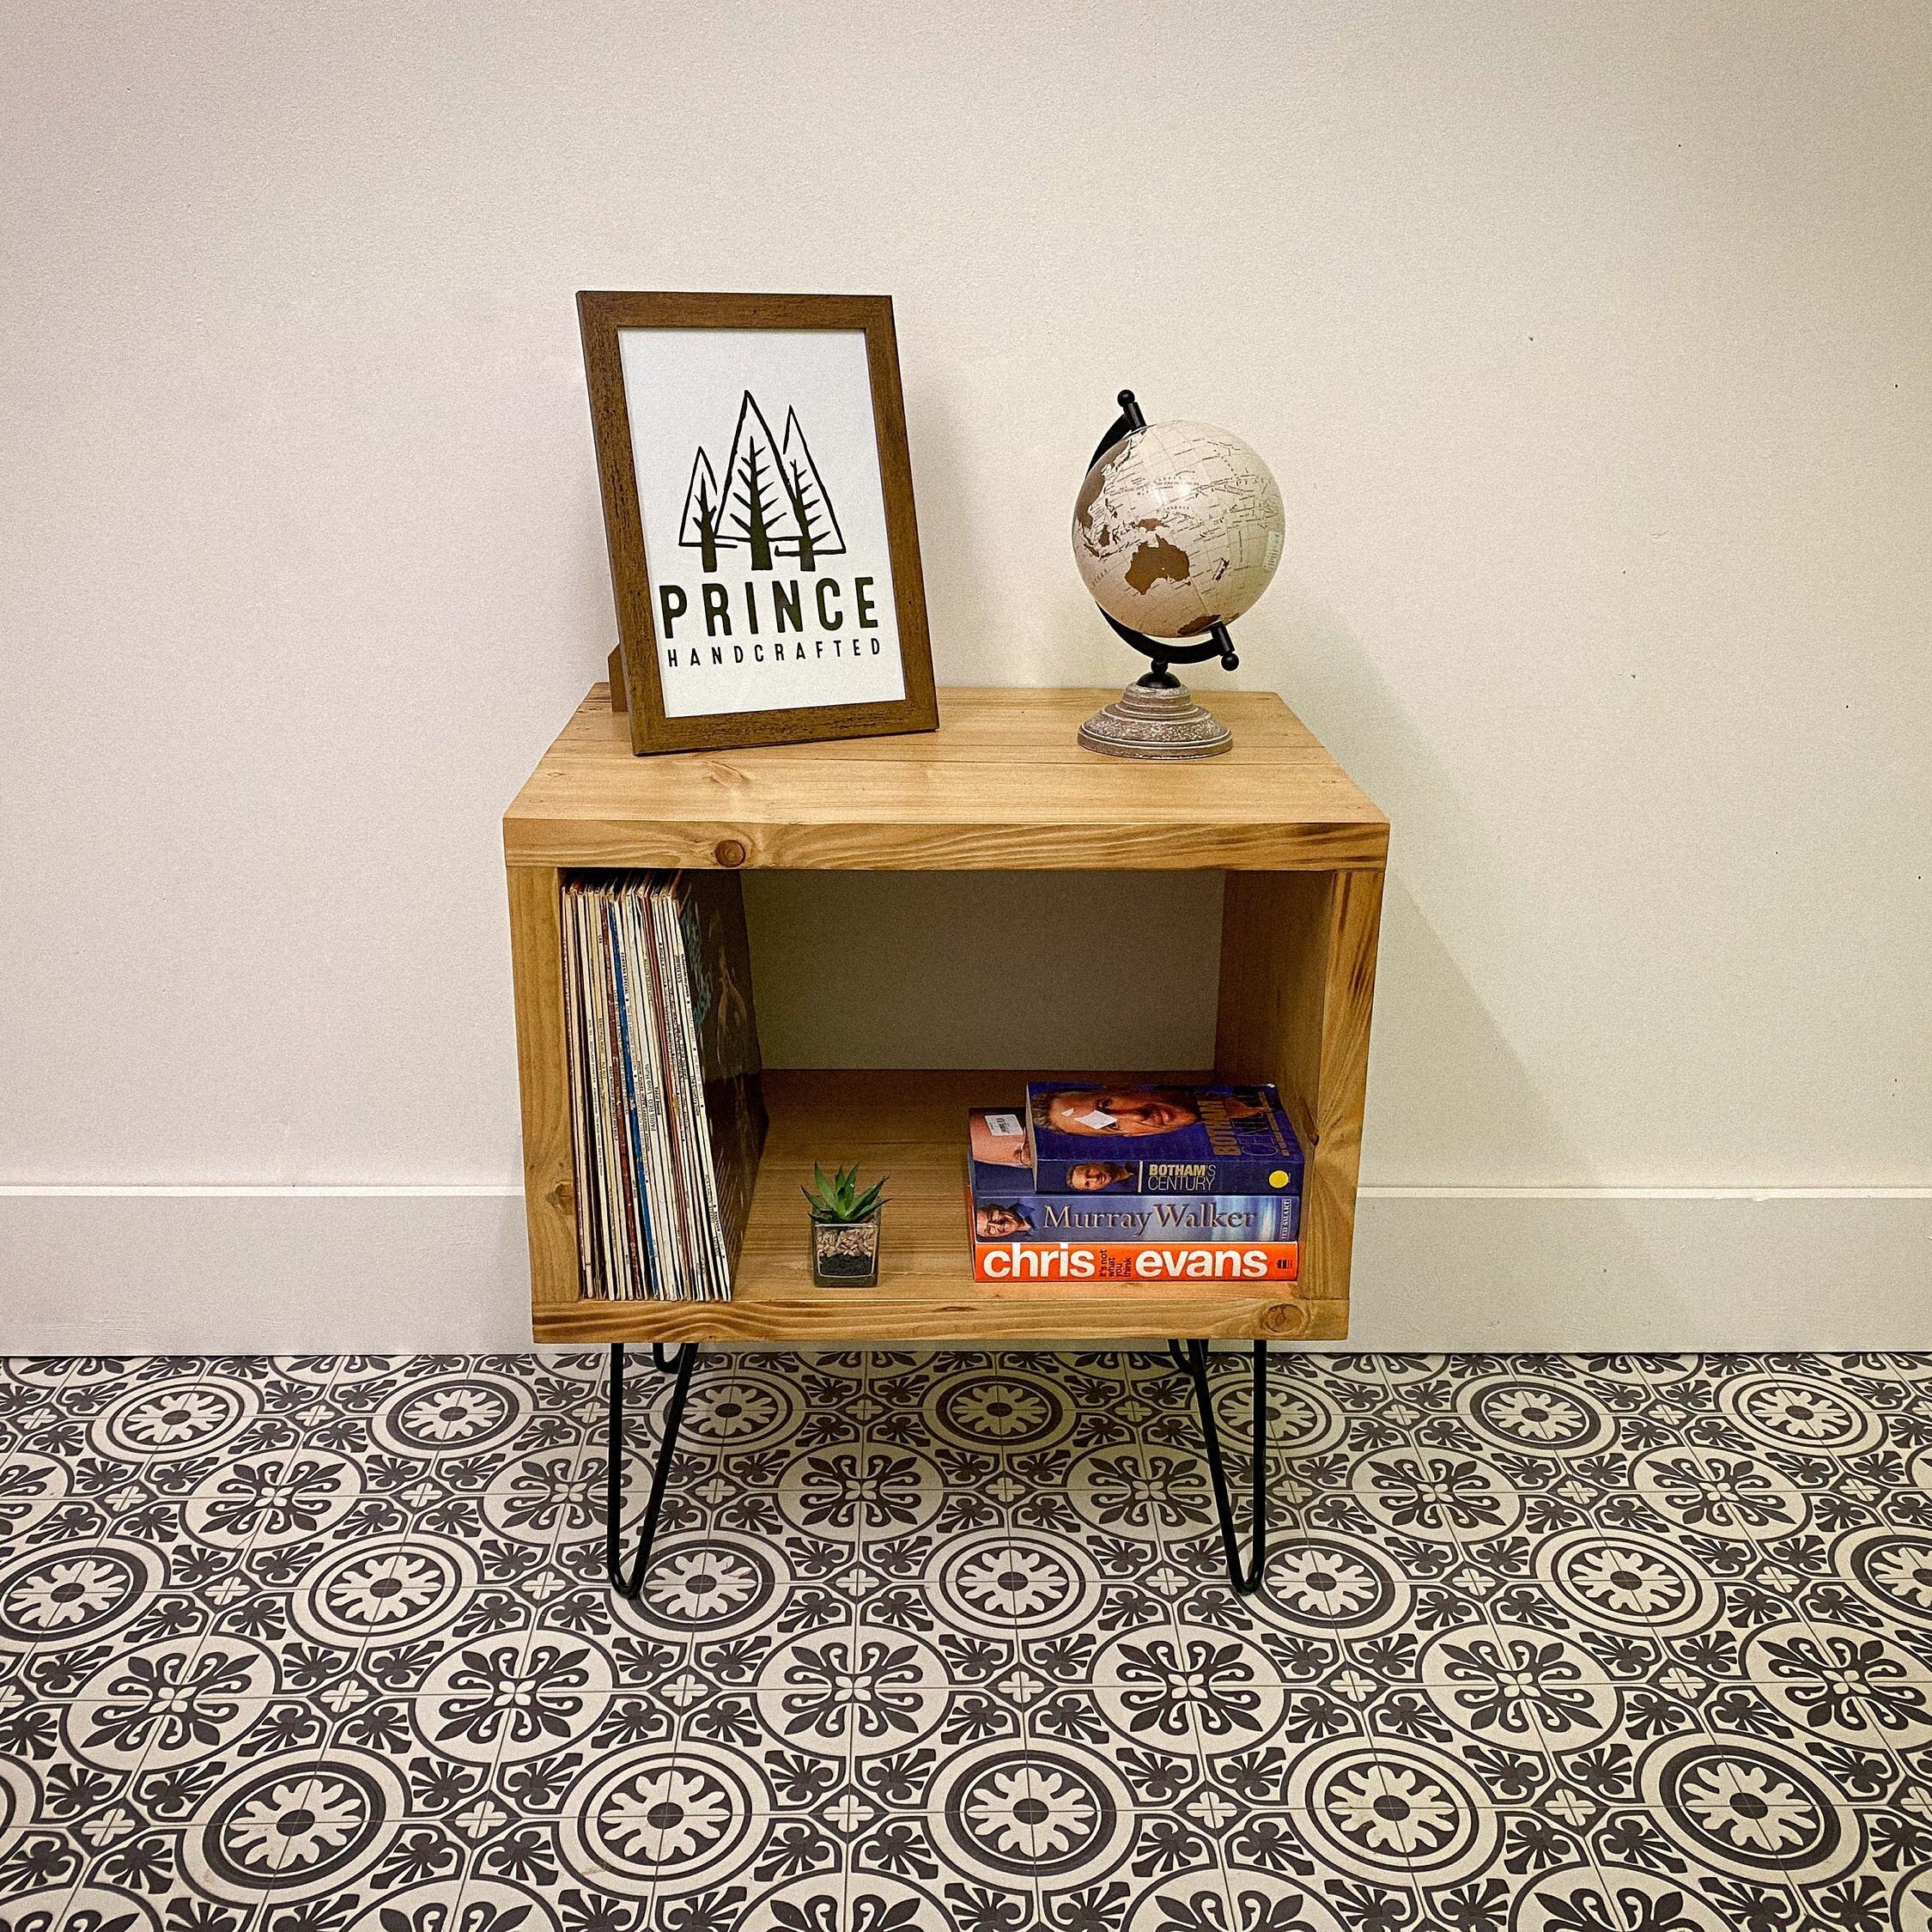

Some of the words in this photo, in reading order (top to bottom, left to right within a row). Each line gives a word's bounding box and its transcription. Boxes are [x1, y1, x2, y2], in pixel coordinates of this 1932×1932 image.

[659, 576, 878, 639] PRINCE
[667, 637, 880, 667] HANDCRAFTED
[1149, 1163, 1217, 1177] BOTHAM'S
[1147, 1176, 1215, 1191] CENTURY
[1042, 1204, 1151, 1237] Murray
[1151, 1202, 1256, 1230] Walker
[1282, 1199, 1291, 1224] SMART
[982, 1242, 1096, 1279] chris
[1134, 1249, 1268, 1279] evans
[1099, 1249, 1108, 1265] not
[1107, 1256, 1115, 1277] what
[1122, 1256, 1132, 1277] think
[1115, 1263, 1124, 1277] you
